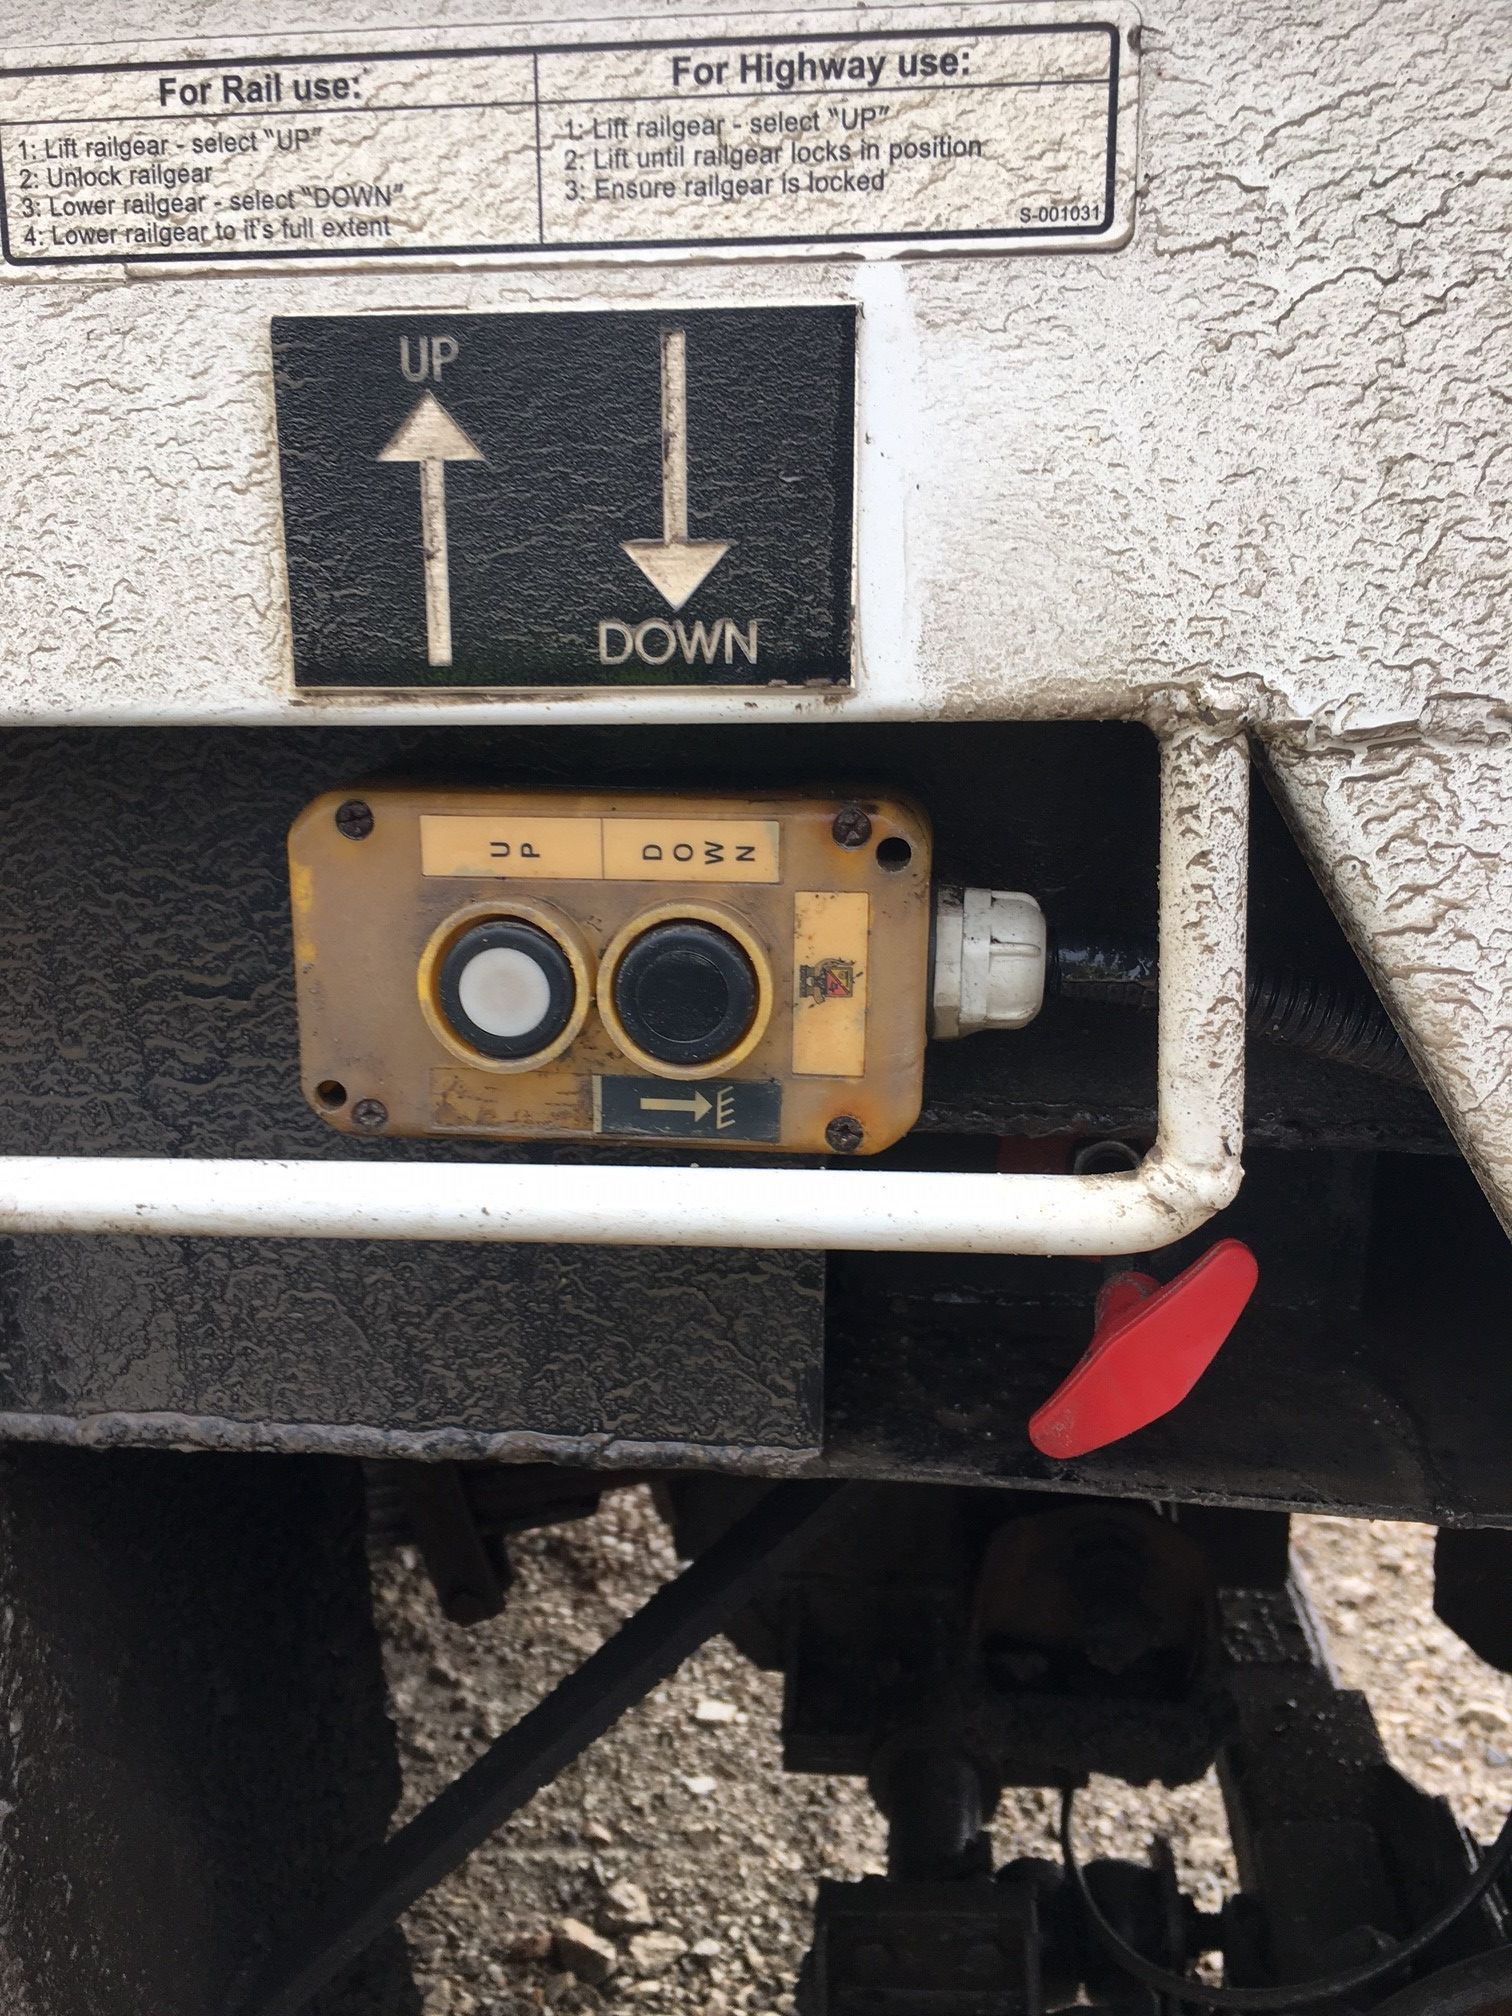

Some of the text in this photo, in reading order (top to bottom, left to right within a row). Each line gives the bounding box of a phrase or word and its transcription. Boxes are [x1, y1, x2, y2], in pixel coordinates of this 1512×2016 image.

[672, 48, 970, 89] For Highway use:
[159, 73, 361, 106] For Rail use:
[565, 119, 582, 140] 1:
[592, 117, 630, 139] Lift
[637, 114, 726, 141] railgear
[749, 112, 821, 134] select
[18, 141, 36, 159] 1:
[45, 140, 77, 158] Lift
[86, 137, 169, 158] railgear
[192, 132, 258, 154] select
[564, 135, 983, 170] 2: Lift until railgear locks in position
[19, 164, 213, 188] 2: Unlock railgear
[565, 169, 886, 201] 3: Ensure railgear is locked
[22, 200, 41, 218] 3:
[50, 198, 115, 217] Lower
[123, 193, 206, 218] railgear
[230, 189, 296, 211] select
[1020, 206, 1100, 221] S-001031
[24, 215, 392, 248] 4: Lower railgear to it's full extent
[400, 335, 460, 383] UP
[598, 618, 760, 666] DOWN
[490, 841, 541, 859] UP
[642, 840, 757, 866] DOWN
